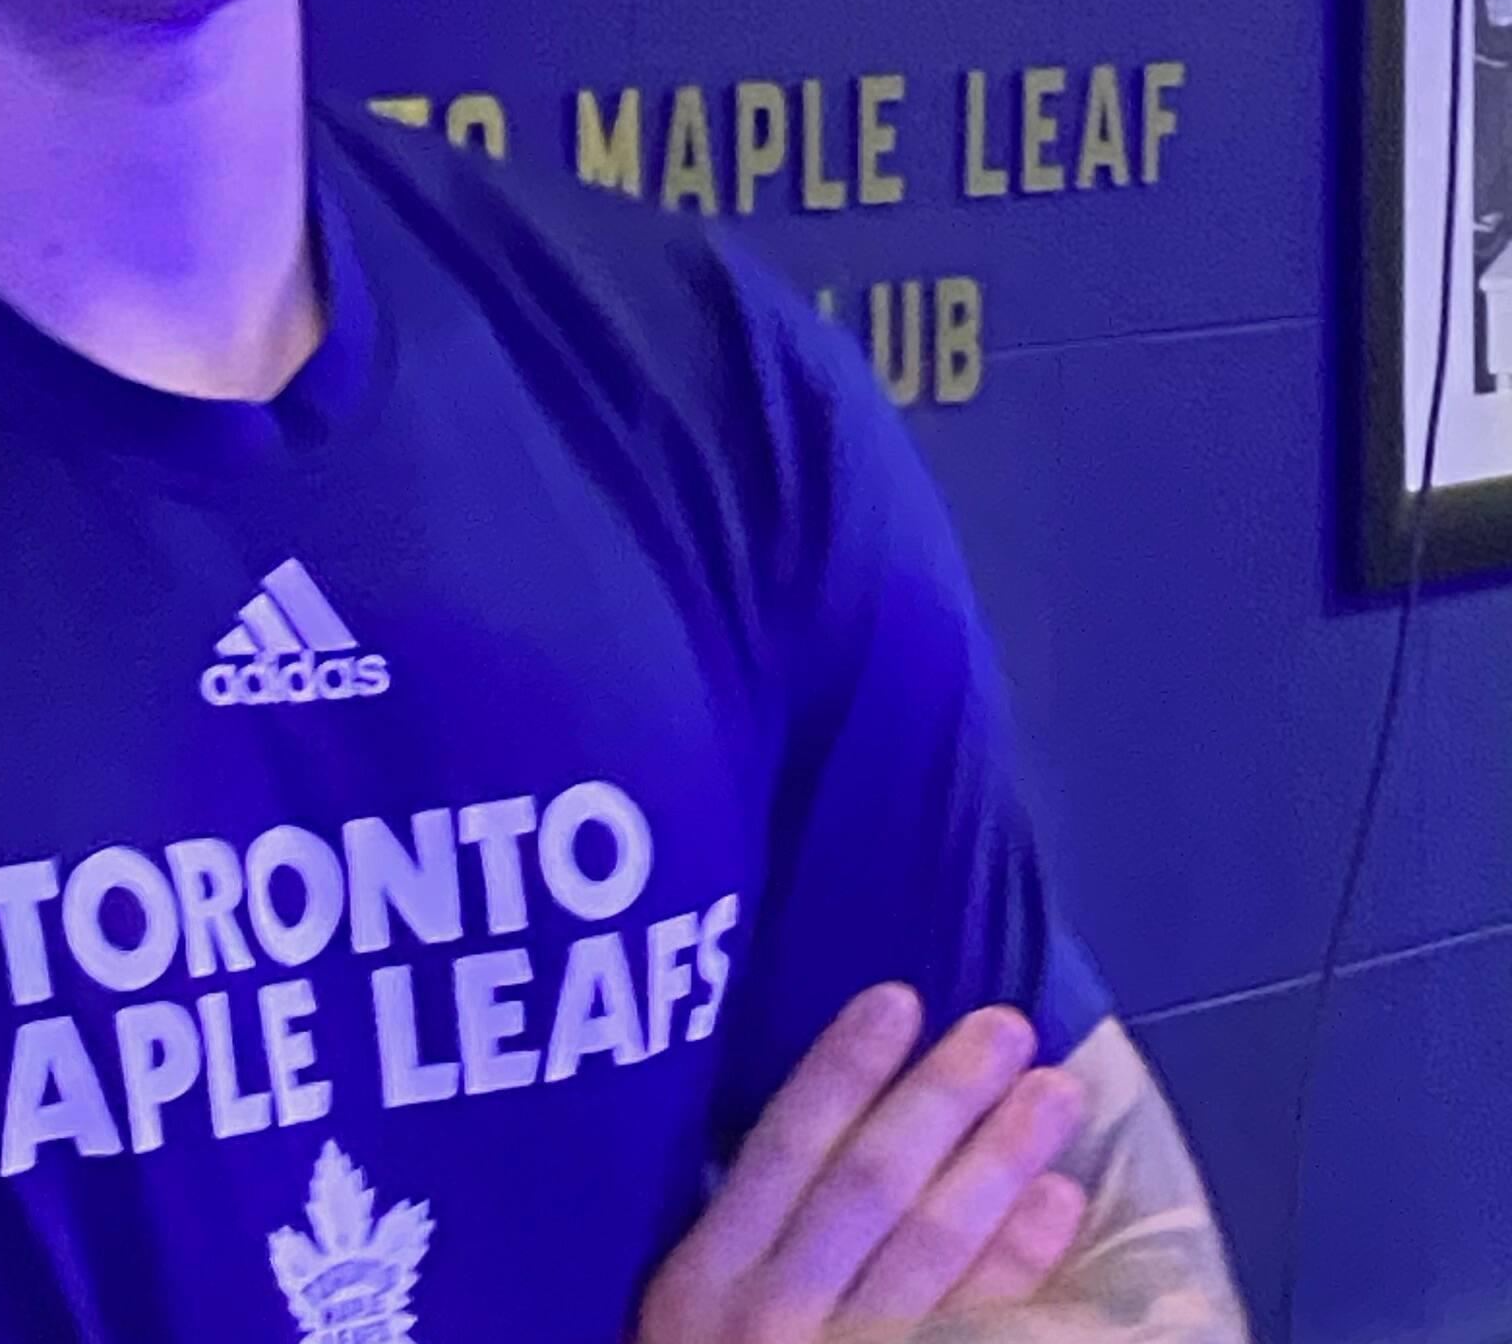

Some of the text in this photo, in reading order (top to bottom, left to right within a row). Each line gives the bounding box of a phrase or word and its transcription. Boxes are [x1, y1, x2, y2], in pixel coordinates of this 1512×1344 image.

[575, 74, 906, 217] MAPLE
[964, 61, 1187, 198] LEAF
[816, 275, 983, 407] UB
[199, 649, 391, 706] adidas
[371, 893, 740, 1109] LEAFS
